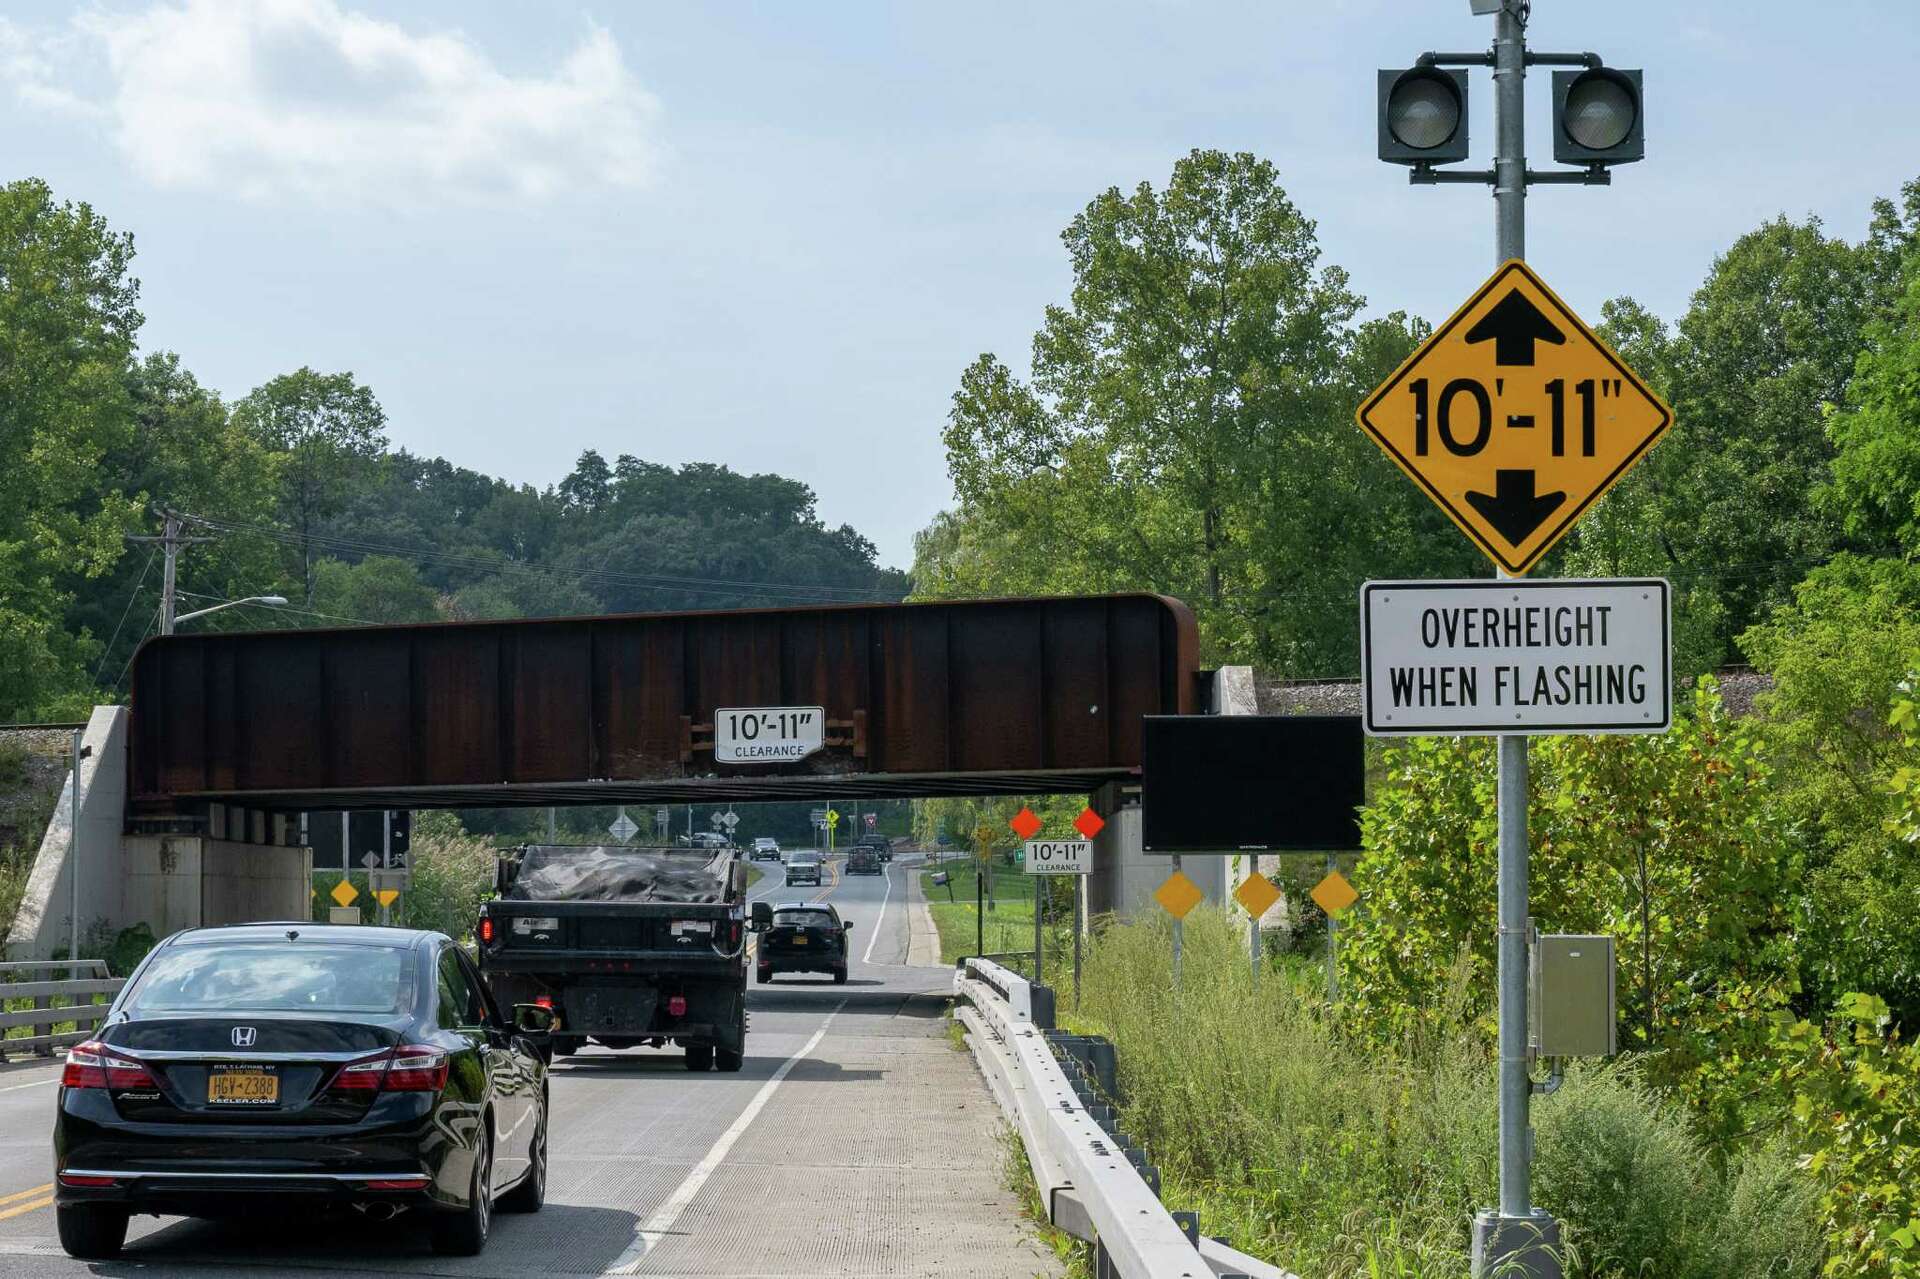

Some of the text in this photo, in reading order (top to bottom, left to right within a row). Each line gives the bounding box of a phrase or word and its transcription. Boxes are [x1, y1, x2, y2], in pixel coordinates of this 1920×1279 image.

[1421, 606, 1612, 649] OVERHEIGHT
[1389, 664, 1646, 708] WHEN FLASHING
[729, 713, 812, 741] 10'-11"
[735, 745, 805, 757] CLEARANCE
[1032, 843, 1086, 861] 10'-11"
